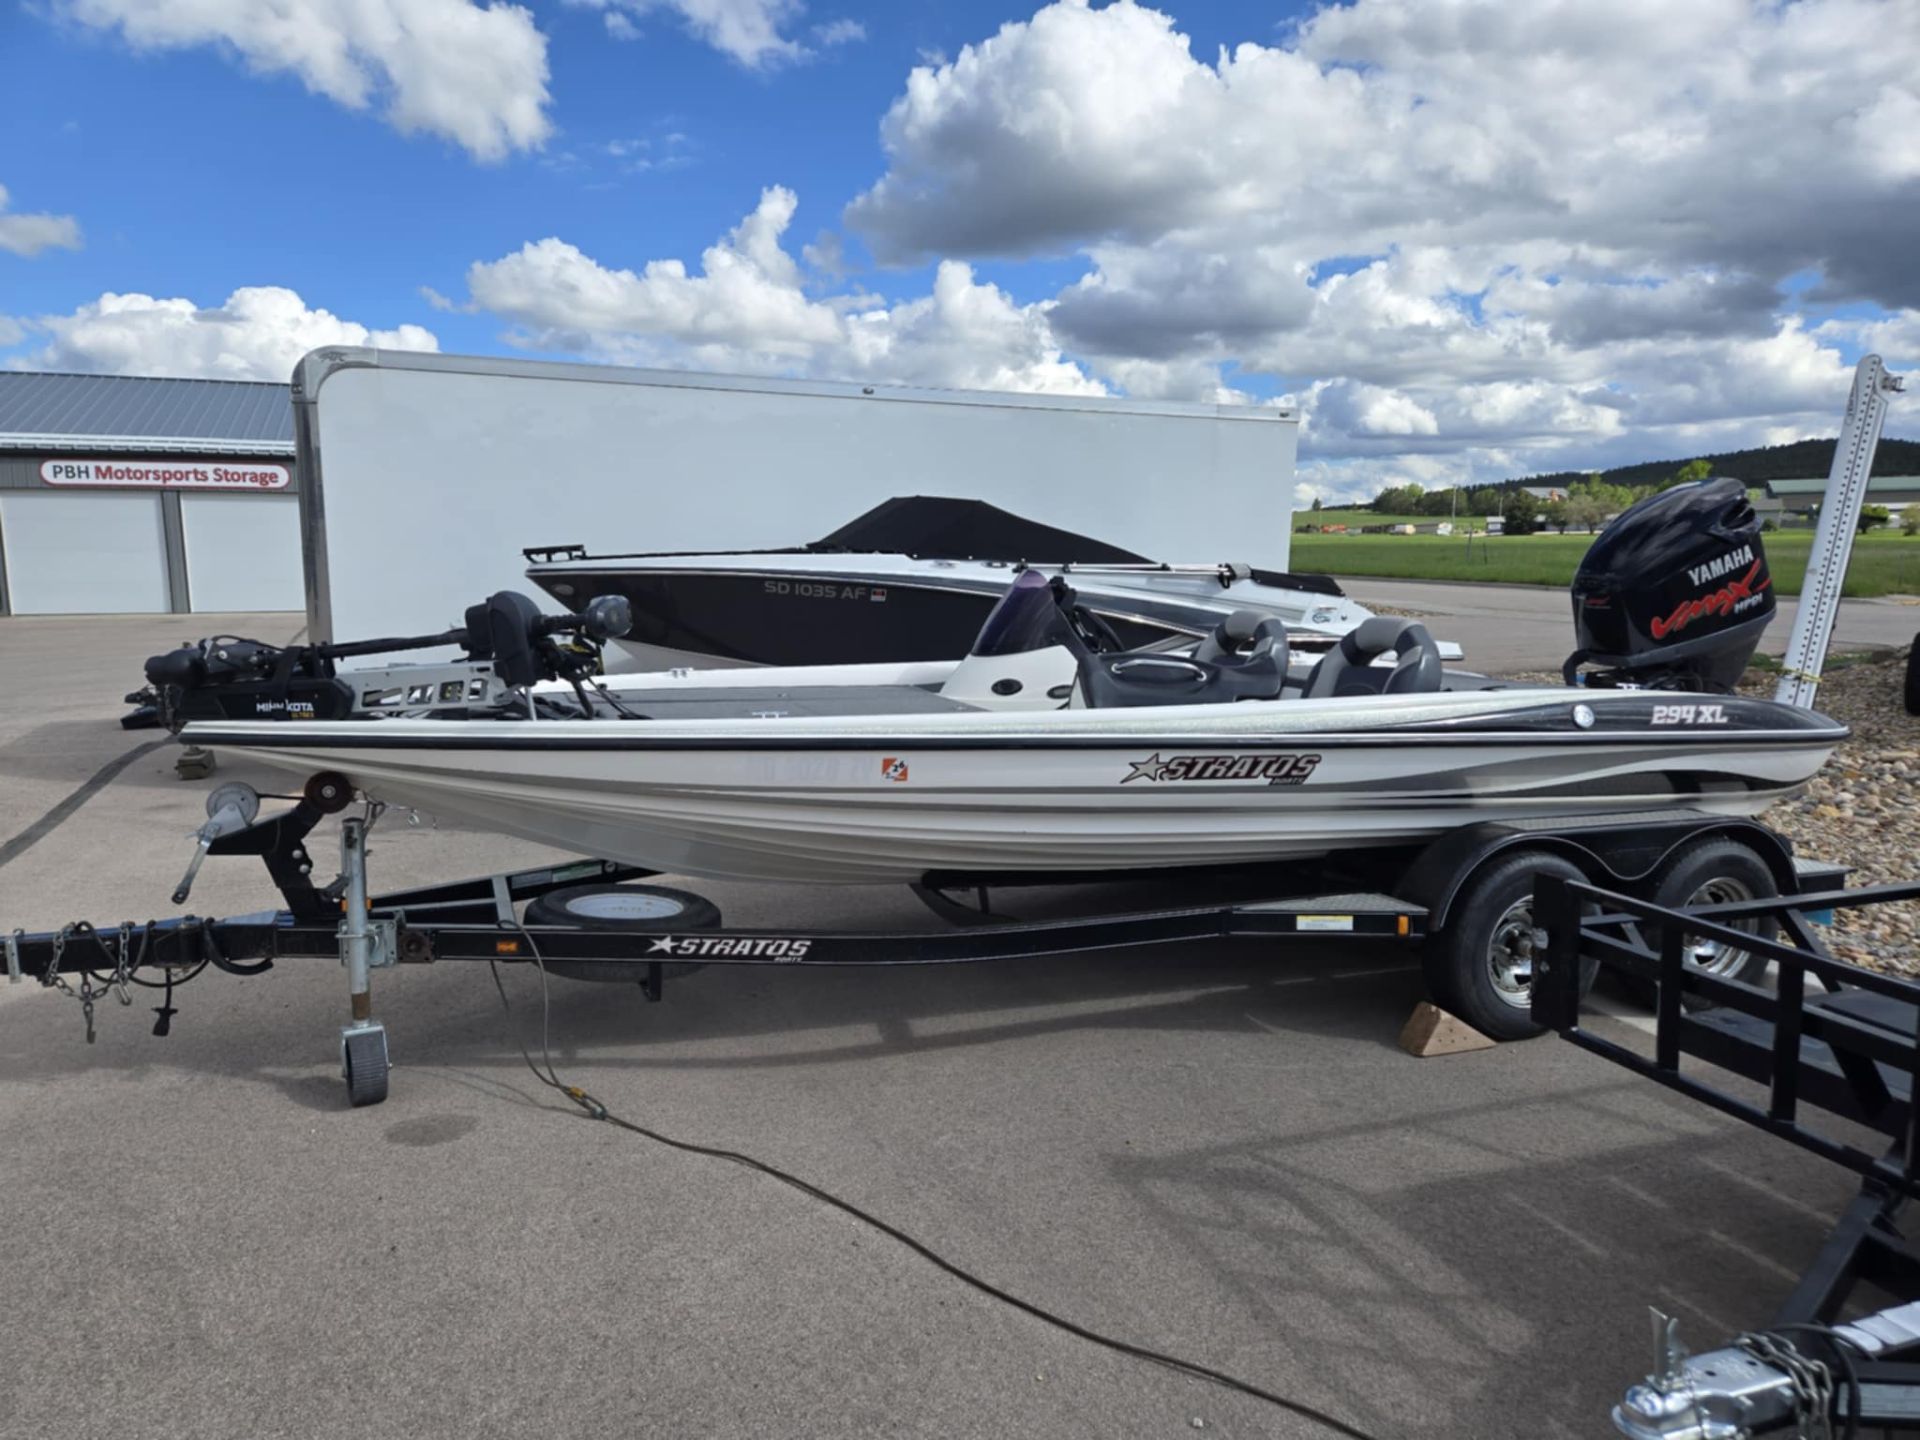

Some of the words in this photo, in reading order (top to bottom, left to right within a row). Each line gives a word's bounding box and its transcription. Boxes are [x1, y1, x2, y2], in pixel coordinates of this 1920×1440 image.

[52, 465, 89, 479] PBH
[95, 465, 209, 484] Motorsports
[213, 468, 279, 486] Storage
[1688, 545, 1754, 586] YAMAHA
[764, 581, 790, 594] SD
[795, 583, 836, 598] 1035
[840, 586, 866, 599] AF
[285, 699, 314, 712] KOTA
[1650, 705, 1696, 725] 294
[1697, 705, 1728, 723] XL
[1160, 754, 1322, 781] STRATOS
[676, 938, 812, 957] STRATOS
